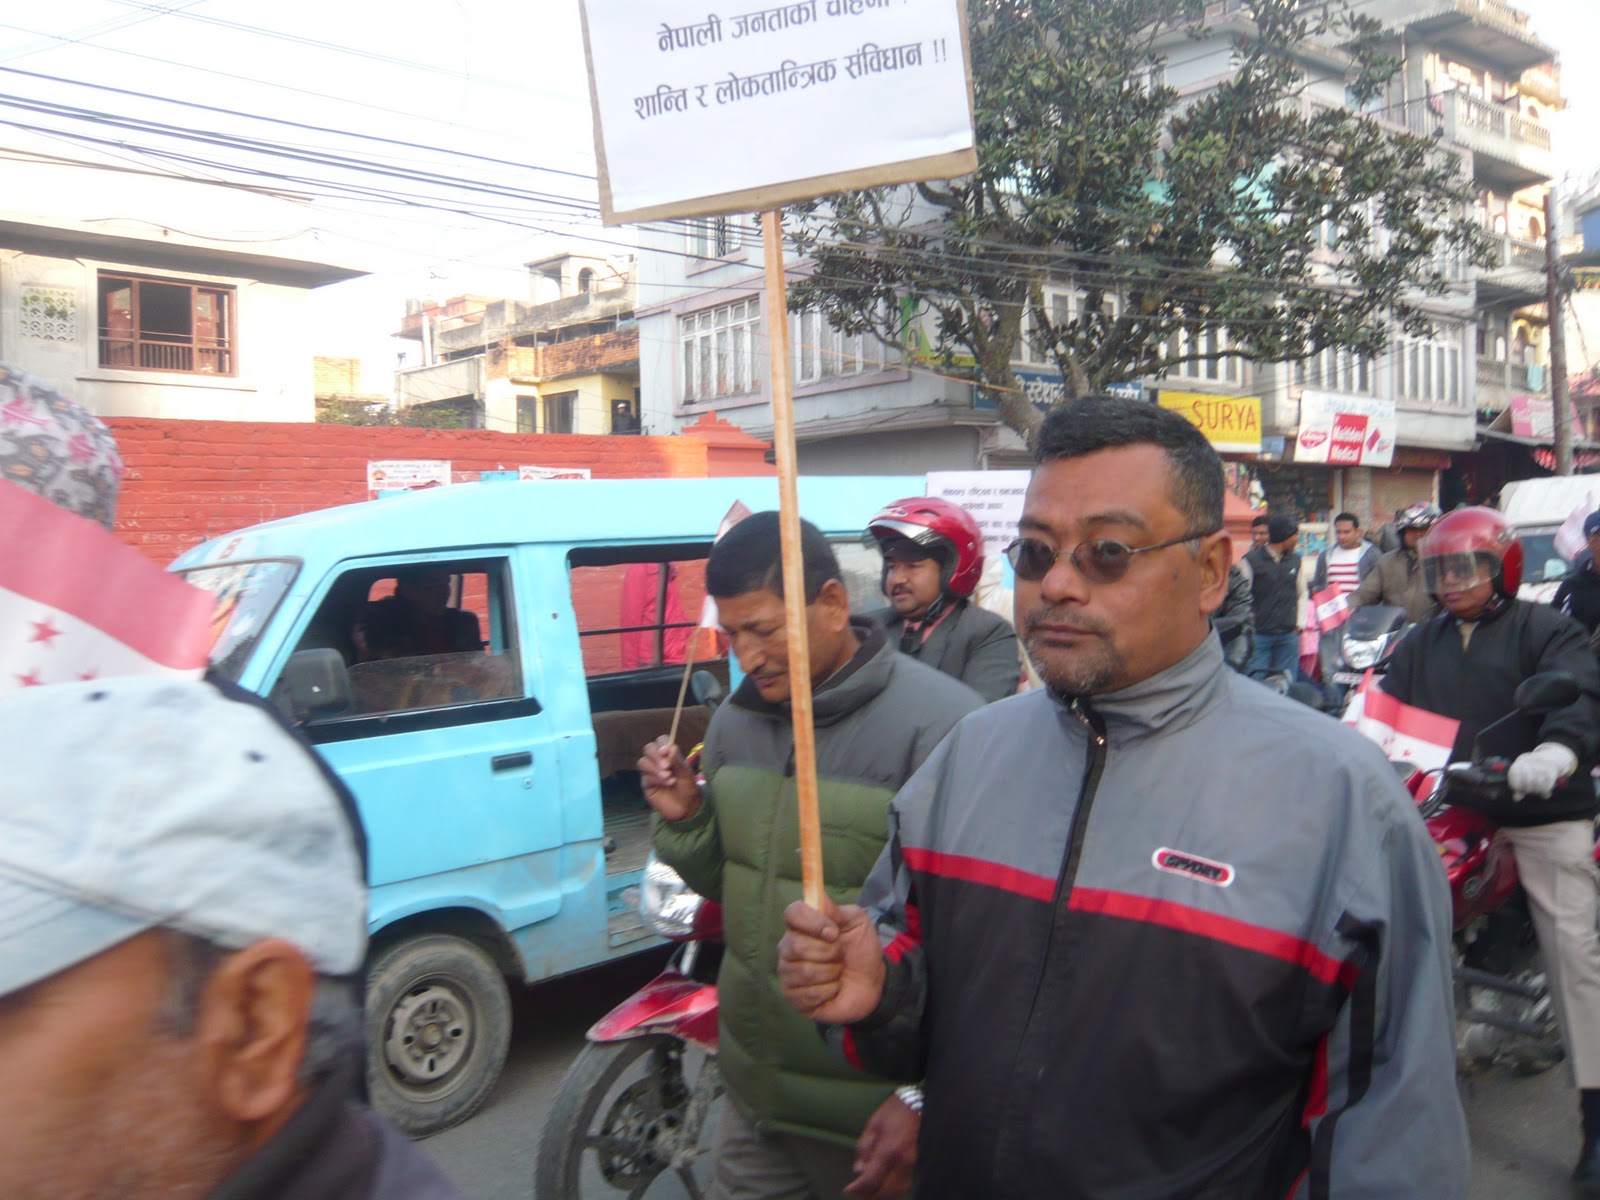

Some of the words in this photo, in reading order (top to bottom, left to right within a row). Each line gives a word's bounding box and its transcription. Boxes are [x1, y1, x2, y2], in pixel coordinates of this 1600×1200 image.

[656, 13, 722, 51] नेपाली
[633, 84, 688, 120] शान्ति
[694, 84, 709, 108] र
[714, 60, 837, 105] लोकतान्त्रिक
[843, 42, 923, 80] संविधान
[1192, 399, 1257, 431] SURYA
